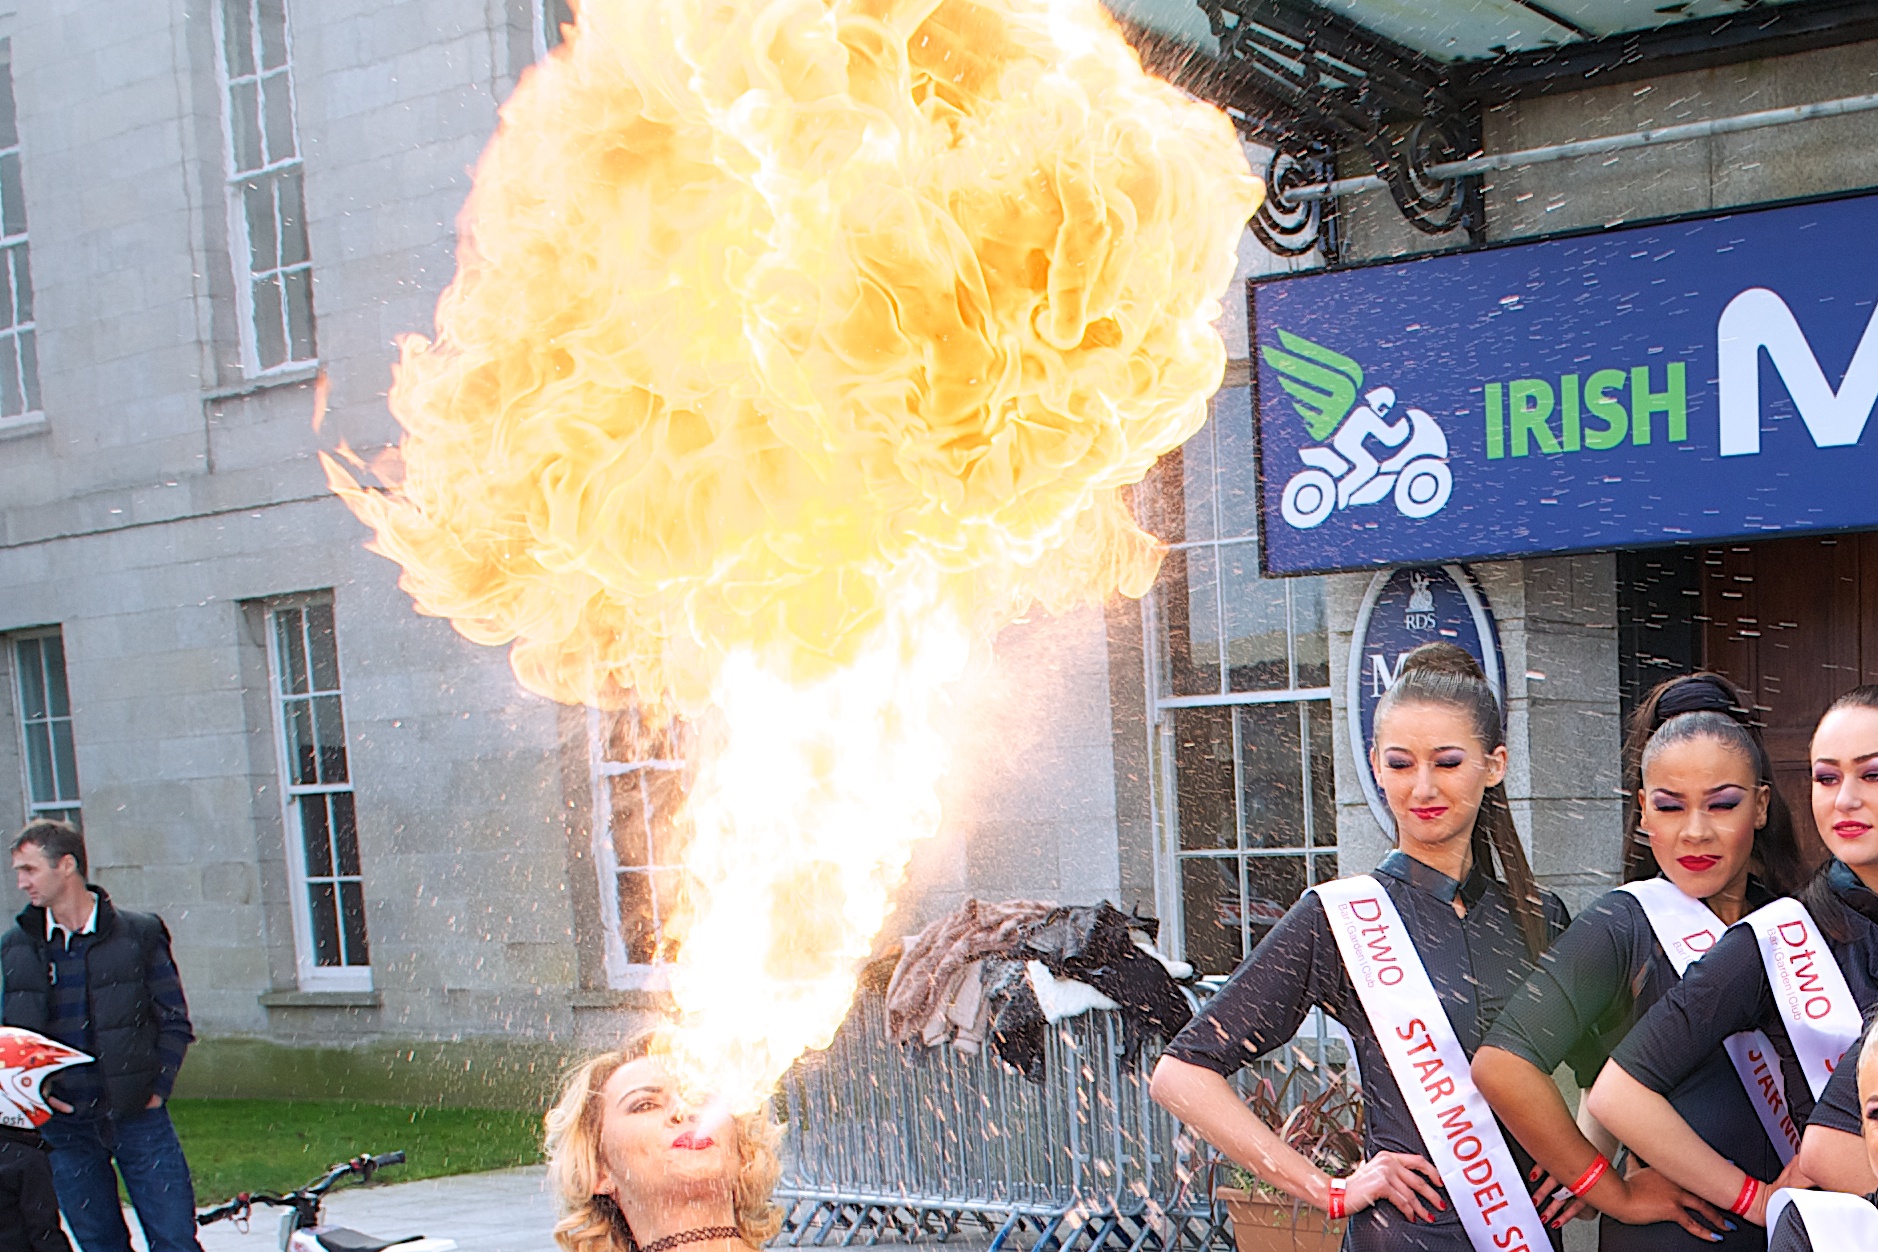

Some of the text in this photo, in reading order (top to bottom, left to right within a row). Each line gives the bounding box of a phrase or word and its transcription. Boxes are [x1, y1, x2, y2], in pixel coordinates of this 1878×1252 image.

[1484, 361, 1687, 459] IRISH
[1406, 613, 1436, 630] RDS
[1349, 898, 1404, 986] Dtwo
[1777, 920, 1831, 1020] Dtwo
[0, 1111, 26, 1127] osh
[1395, 1018, 1455, 1106] STAR
[1437, 1104, 1509, 1226] MODEL
